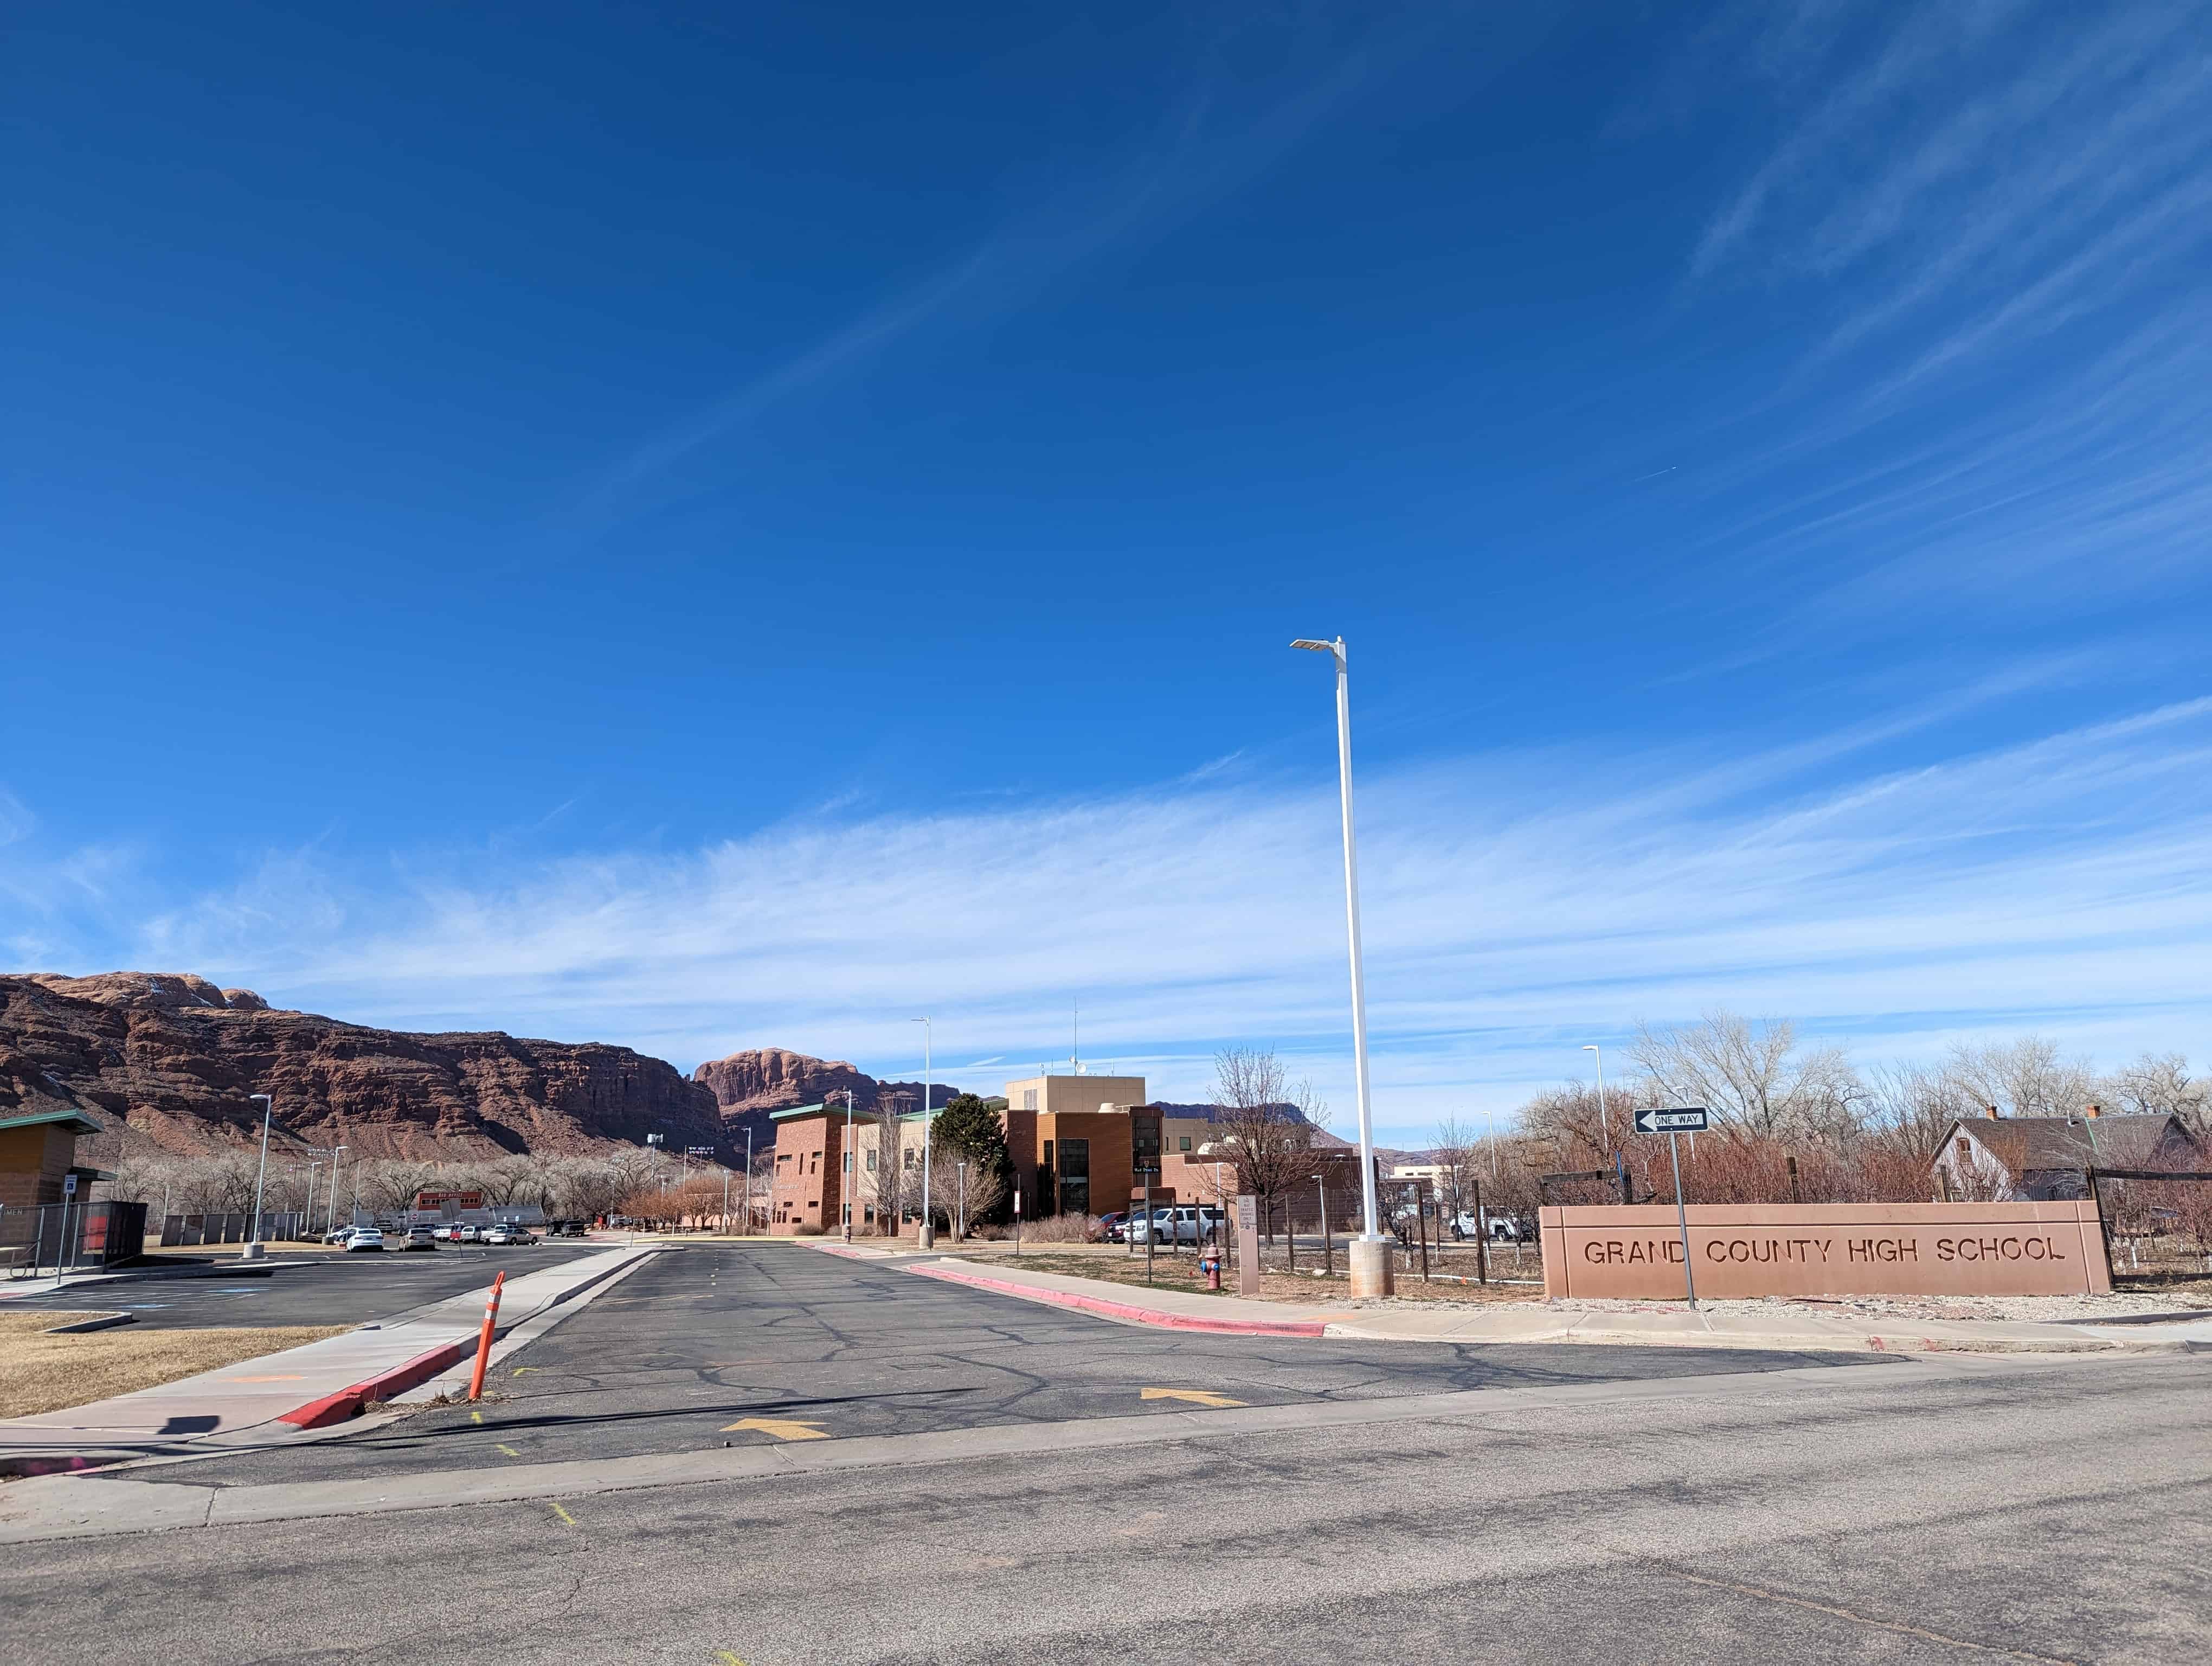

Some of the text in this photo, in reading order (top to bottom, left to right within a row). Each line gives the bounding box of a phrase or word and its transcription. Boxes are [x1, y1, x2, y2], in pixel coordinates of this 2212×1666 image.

[1655, 1114, 1698, 1125] ONE WAY
[1584, 1237, 2066, 1264] GRAND COUNTY HIGH SCHOOL
